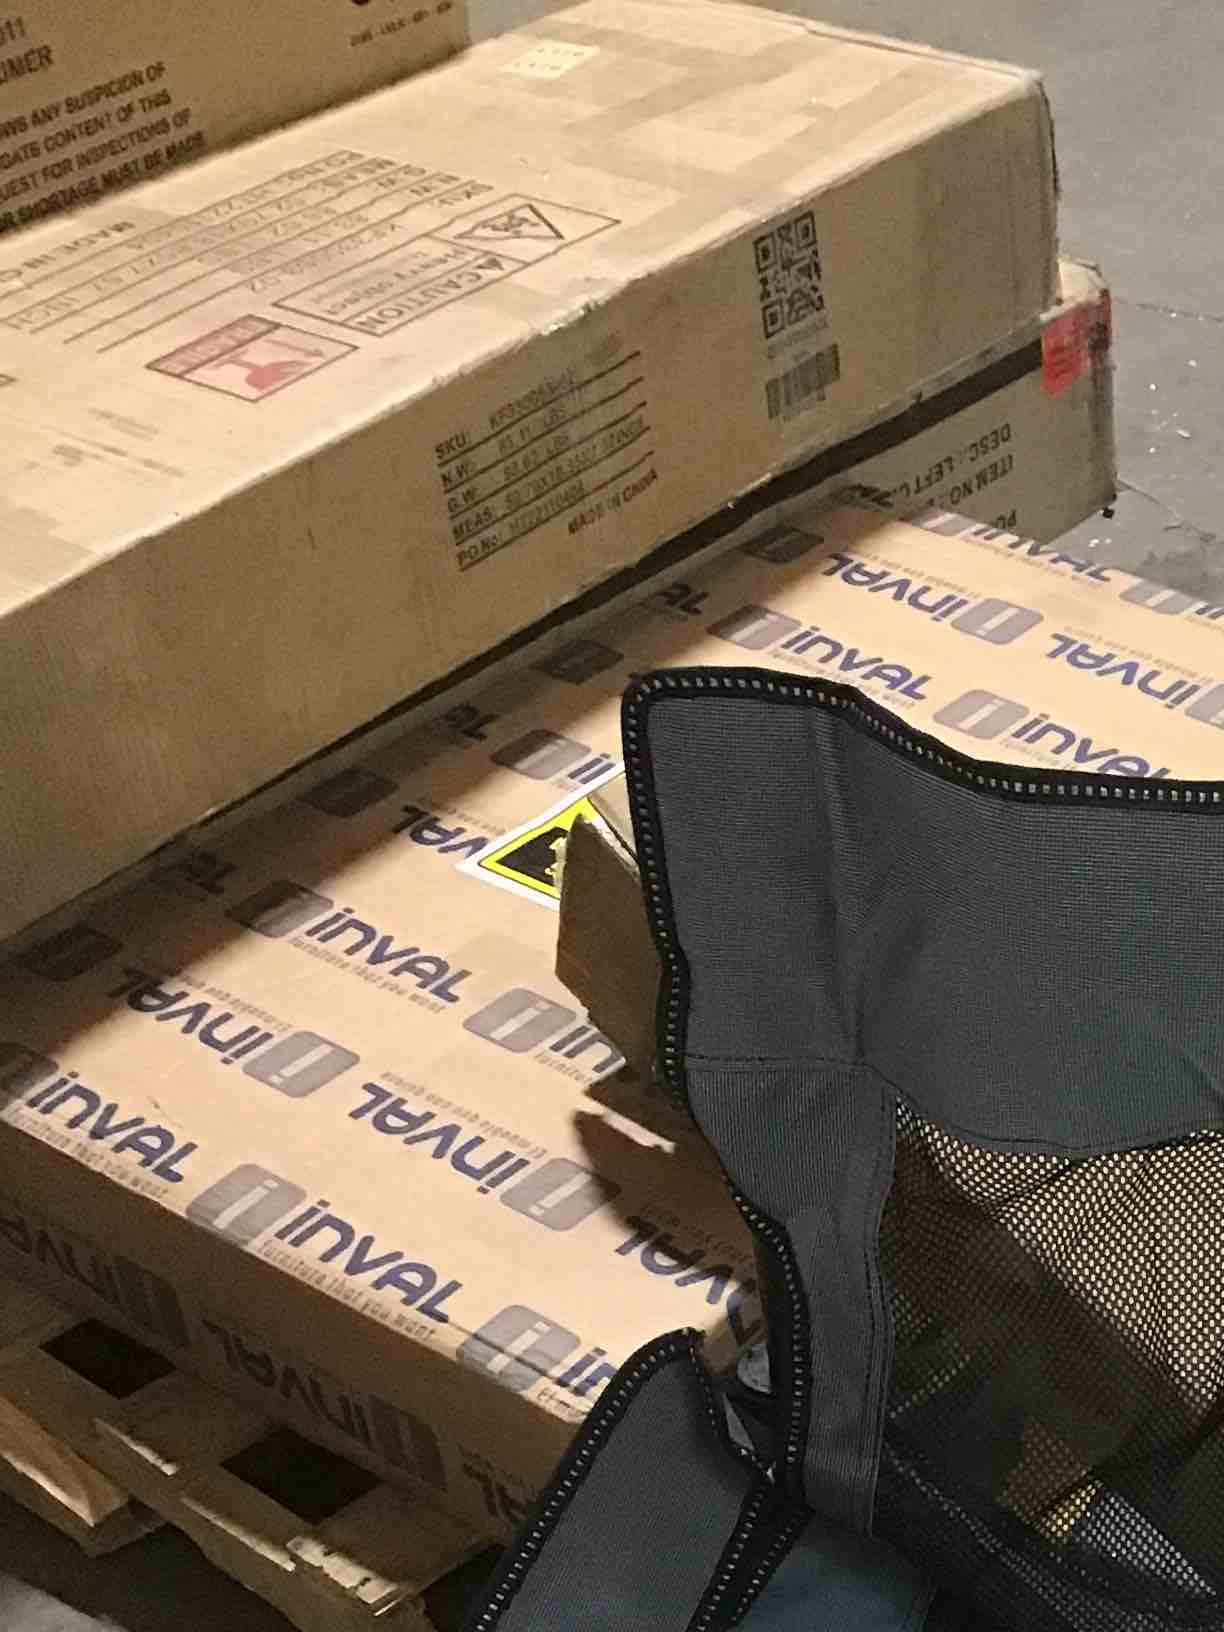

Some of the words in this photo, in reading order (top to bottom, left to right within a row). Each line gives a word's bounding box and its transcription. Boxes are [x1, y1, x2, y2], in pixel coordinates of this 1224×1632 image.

[31, 104, 60, 126] ANY
[64, 69, 144, 115] SUSPICION
[146, 61, 166, 81] OF
[44, 112, 112, 151] CONTENT
[116, 103, 134, 123] OF
[139, 88, 171, 112] THIS
[42, 158, 72, 181] FOR
[75, 117, 170, 169] INSPECTIONS
[172, 107, 191, 128] OF
[101, 159, 140, 188] MUST
[355, 271, 482, 328] CAUTION
[568, 504, 604, 535] MADE
[606, 494, 622, 513] IN
[623, 468, 658, 502] CHINA
[914, 456, 954, 494] LEFT
[976, 454, 1014, 491] ITEM
[258, 1240, 327, 1286] furniture
[329, 1273, 363, 1303] that
[361, 1302, 388, 1323] you
[395, 1313, 436, 1340] want
